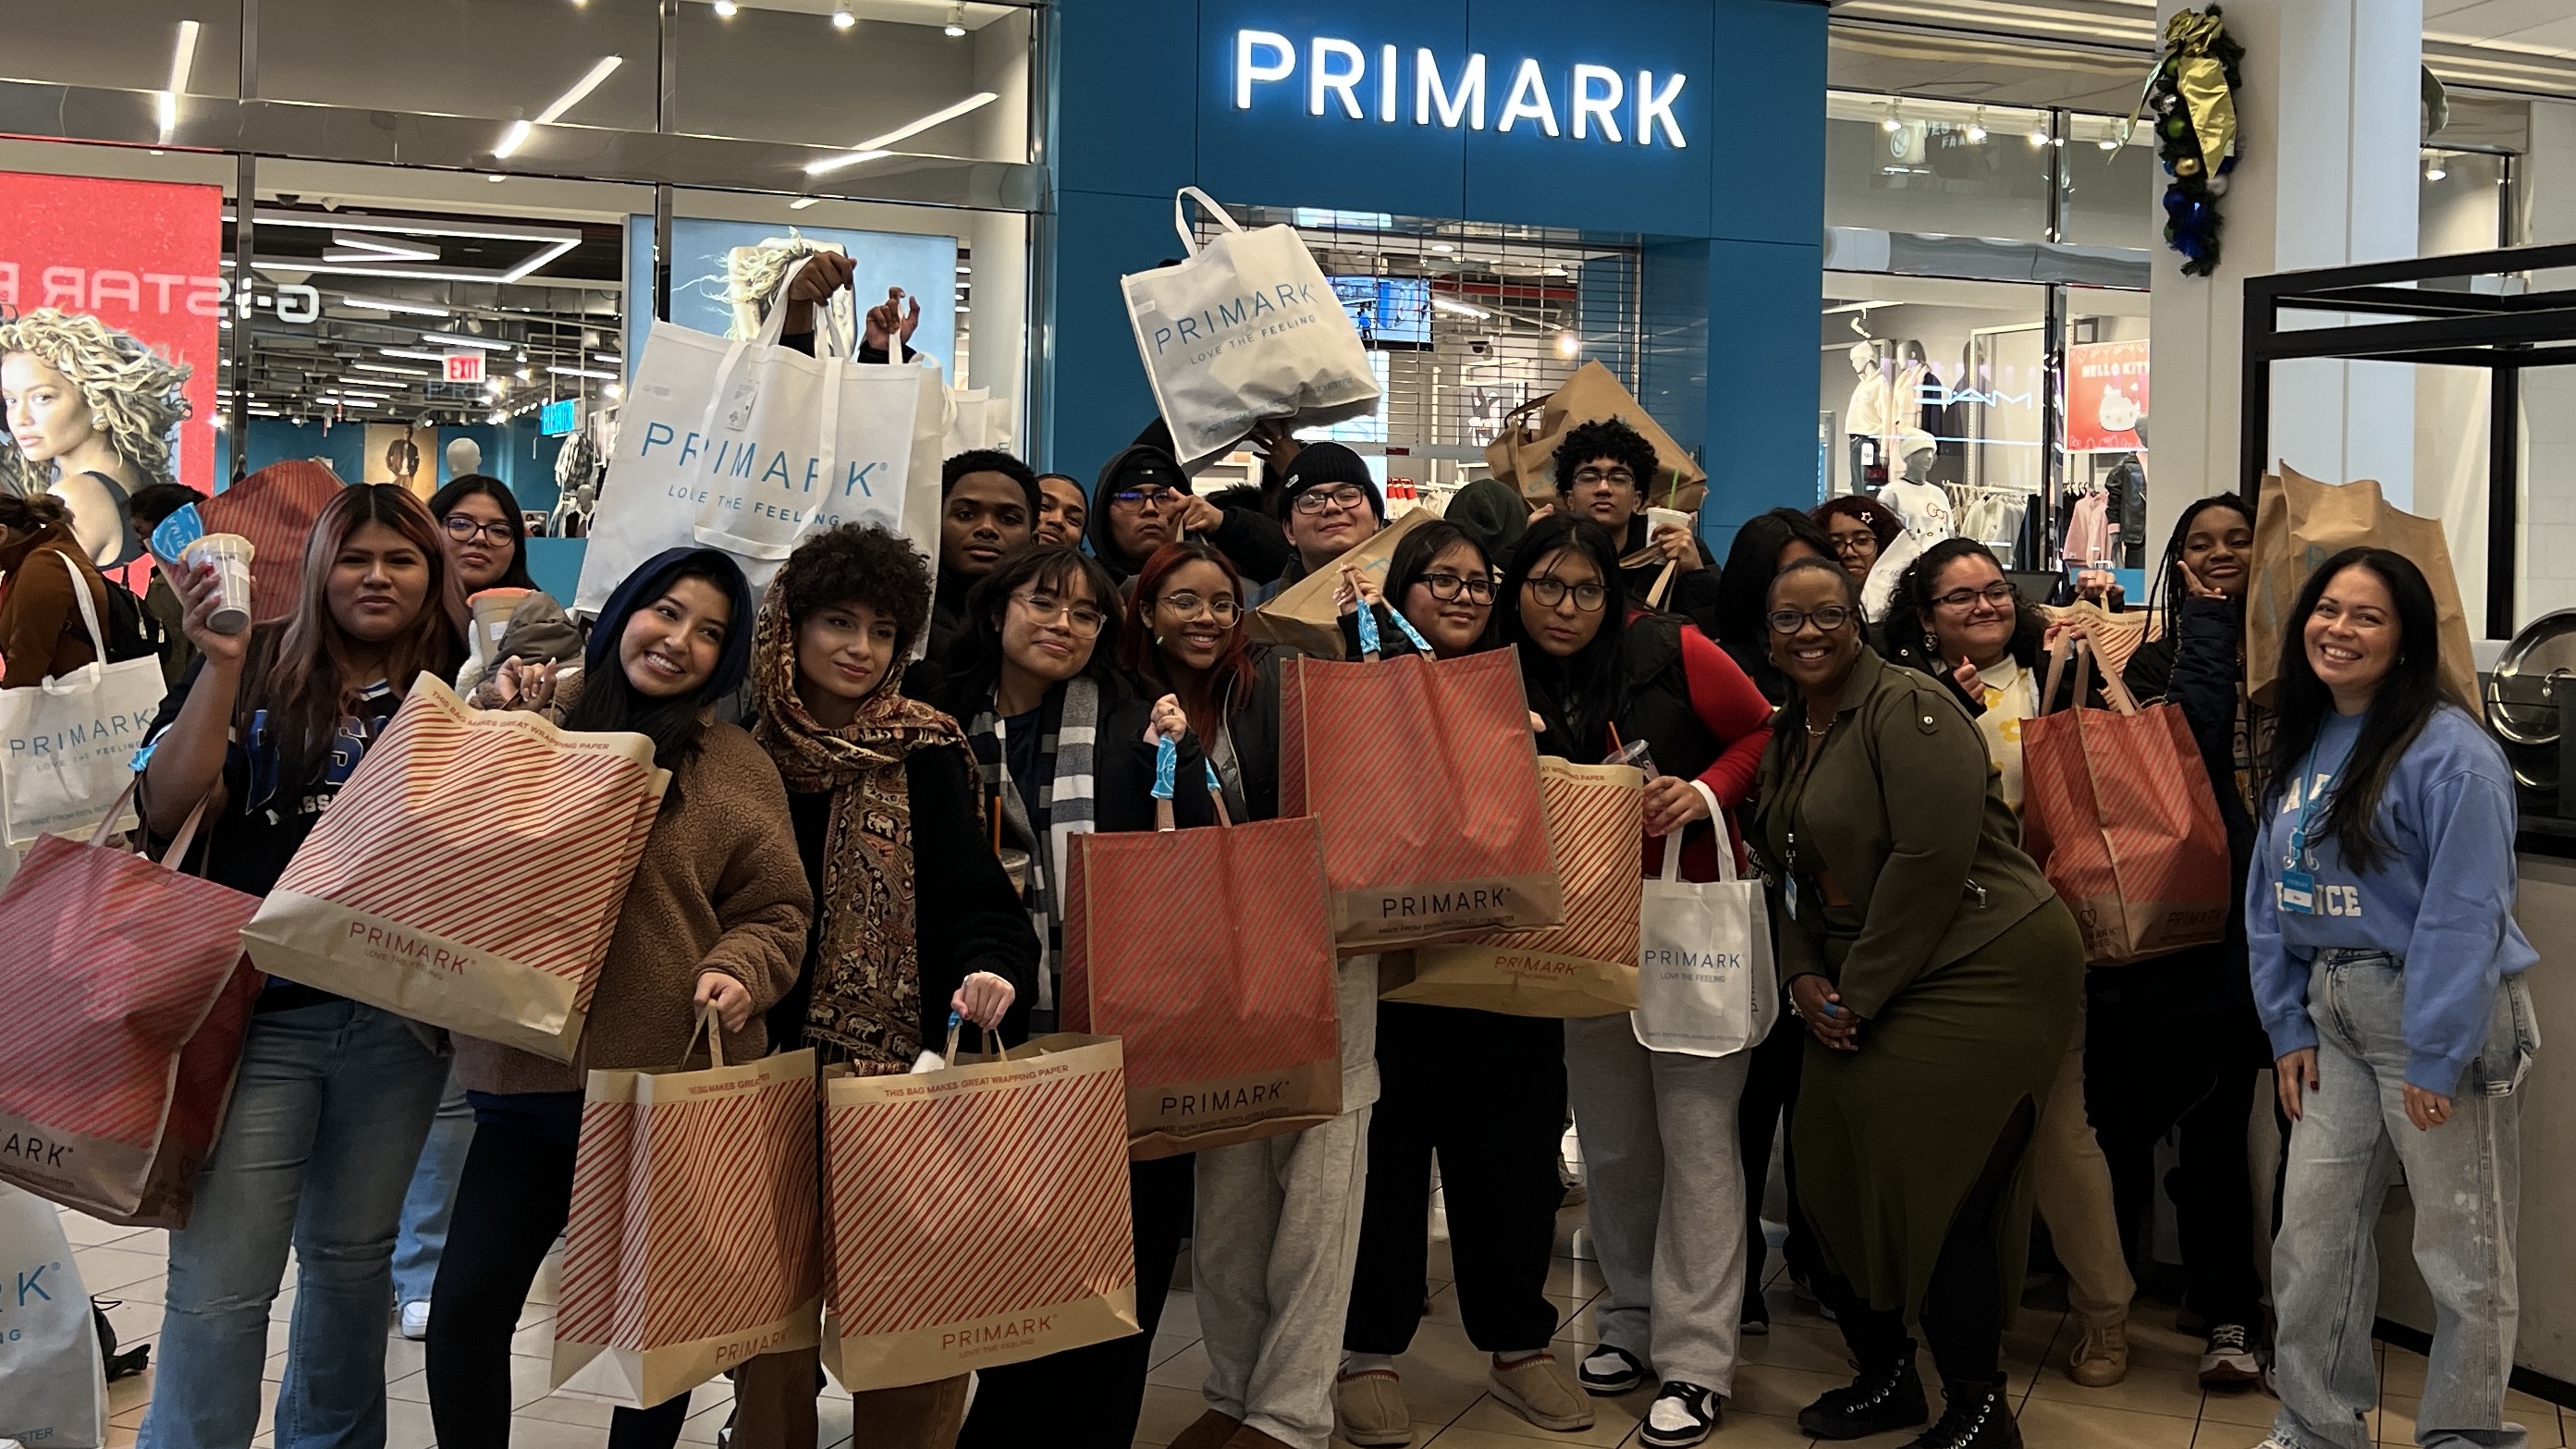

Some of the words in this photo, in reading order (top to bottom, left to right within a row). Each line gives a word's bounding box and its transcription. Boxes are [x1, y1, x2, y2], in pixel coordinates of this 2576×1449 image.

[1234, 29, 1689, 149] PRIMARK
[1155, 281, 1319, 355] PRIMARK
[1189, 345, 1222, 365] LOVE
[1229, 334, 1255, 350] THE
[1261, 314, 1317, 338] FEELING
[450, 357, 480, 380] EXIT
[2081, 362, 2120, 378] HELLO
[2122, 360, 2150, 375] KITT
[718, 495, 742, 510] THE
[754, 502, 840, 526] FEELNG
[9, 708, 153, 758] PRIMARK
[431, 690, 450, 709] THIS
[449, 706, 466, 723] BAG
[468, 718, 498, 728] MAKES
[499, 719, 530, 729] GREAT
[531, 724, 577, 749] WRAPPING
[1382, 887, 1504, 918] PRIMARK
[350, 921, 470, 976] PRIMARK
[1645, 950, 1740, 969] PRIMARK
[1494, 956, 1578, 976] PRIMARK
[884, 1088, 904, 1097] THIS
[906, 1087, 925, 1096] BAG
[926, 1081, 959, 1094] MAKES
[961, 1076, 989, 1087] GREAT
[991, 1071, 1037, 1085] WRAPPING
[1038, 1064, 1069, 1076] PAPER
[1160, 1081, 1283, 1116] PRIMARK
[942, 1316, 1052, 1350] PRIMARK
